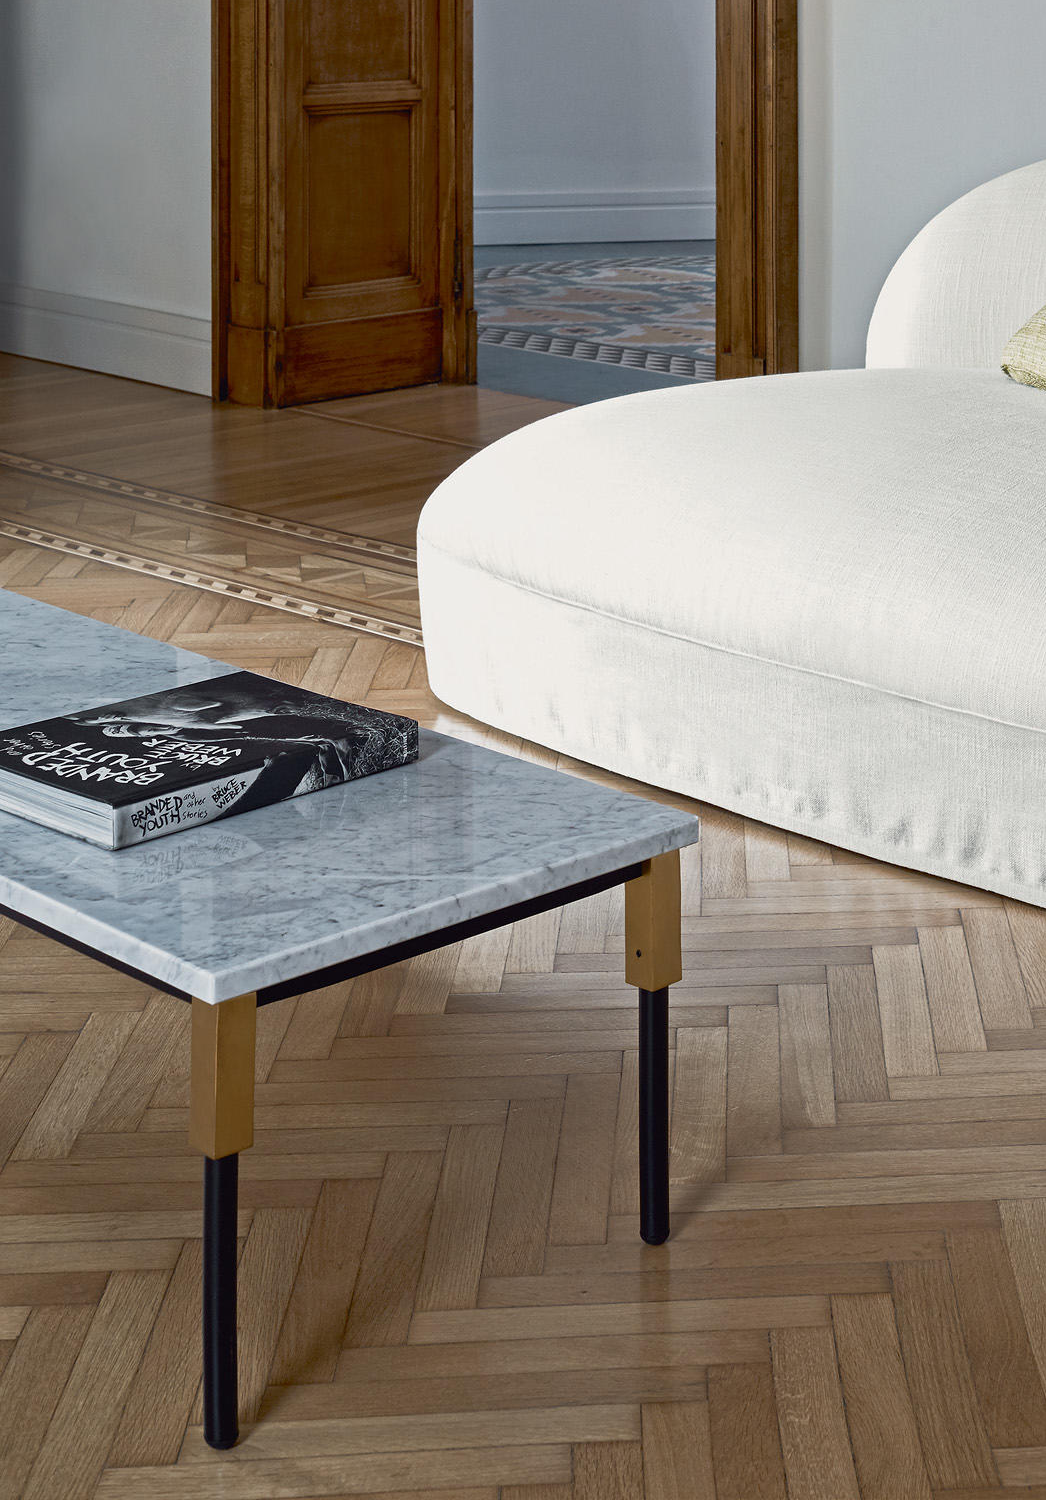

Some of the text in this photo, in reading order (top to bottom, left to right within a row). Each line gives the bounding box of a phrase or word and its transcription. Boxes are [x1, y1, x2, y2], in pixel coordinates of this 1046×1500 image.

[55, 741, 173, 772] YOUTH
[142, 738, 242, 756] WEBER
[143, 750, 231, 767] BRUCE
[21, 751, 165, 786] BRANDED
[183, 791, 196, 801] and
[186, 796, 207, 808] other
[211, 777, 240, 803] BRUCE
[216, 781, 247, 809] WEBER
[130, 796, 183, 828] BRANDED
[139, 809, 181, 837] YOUTH
